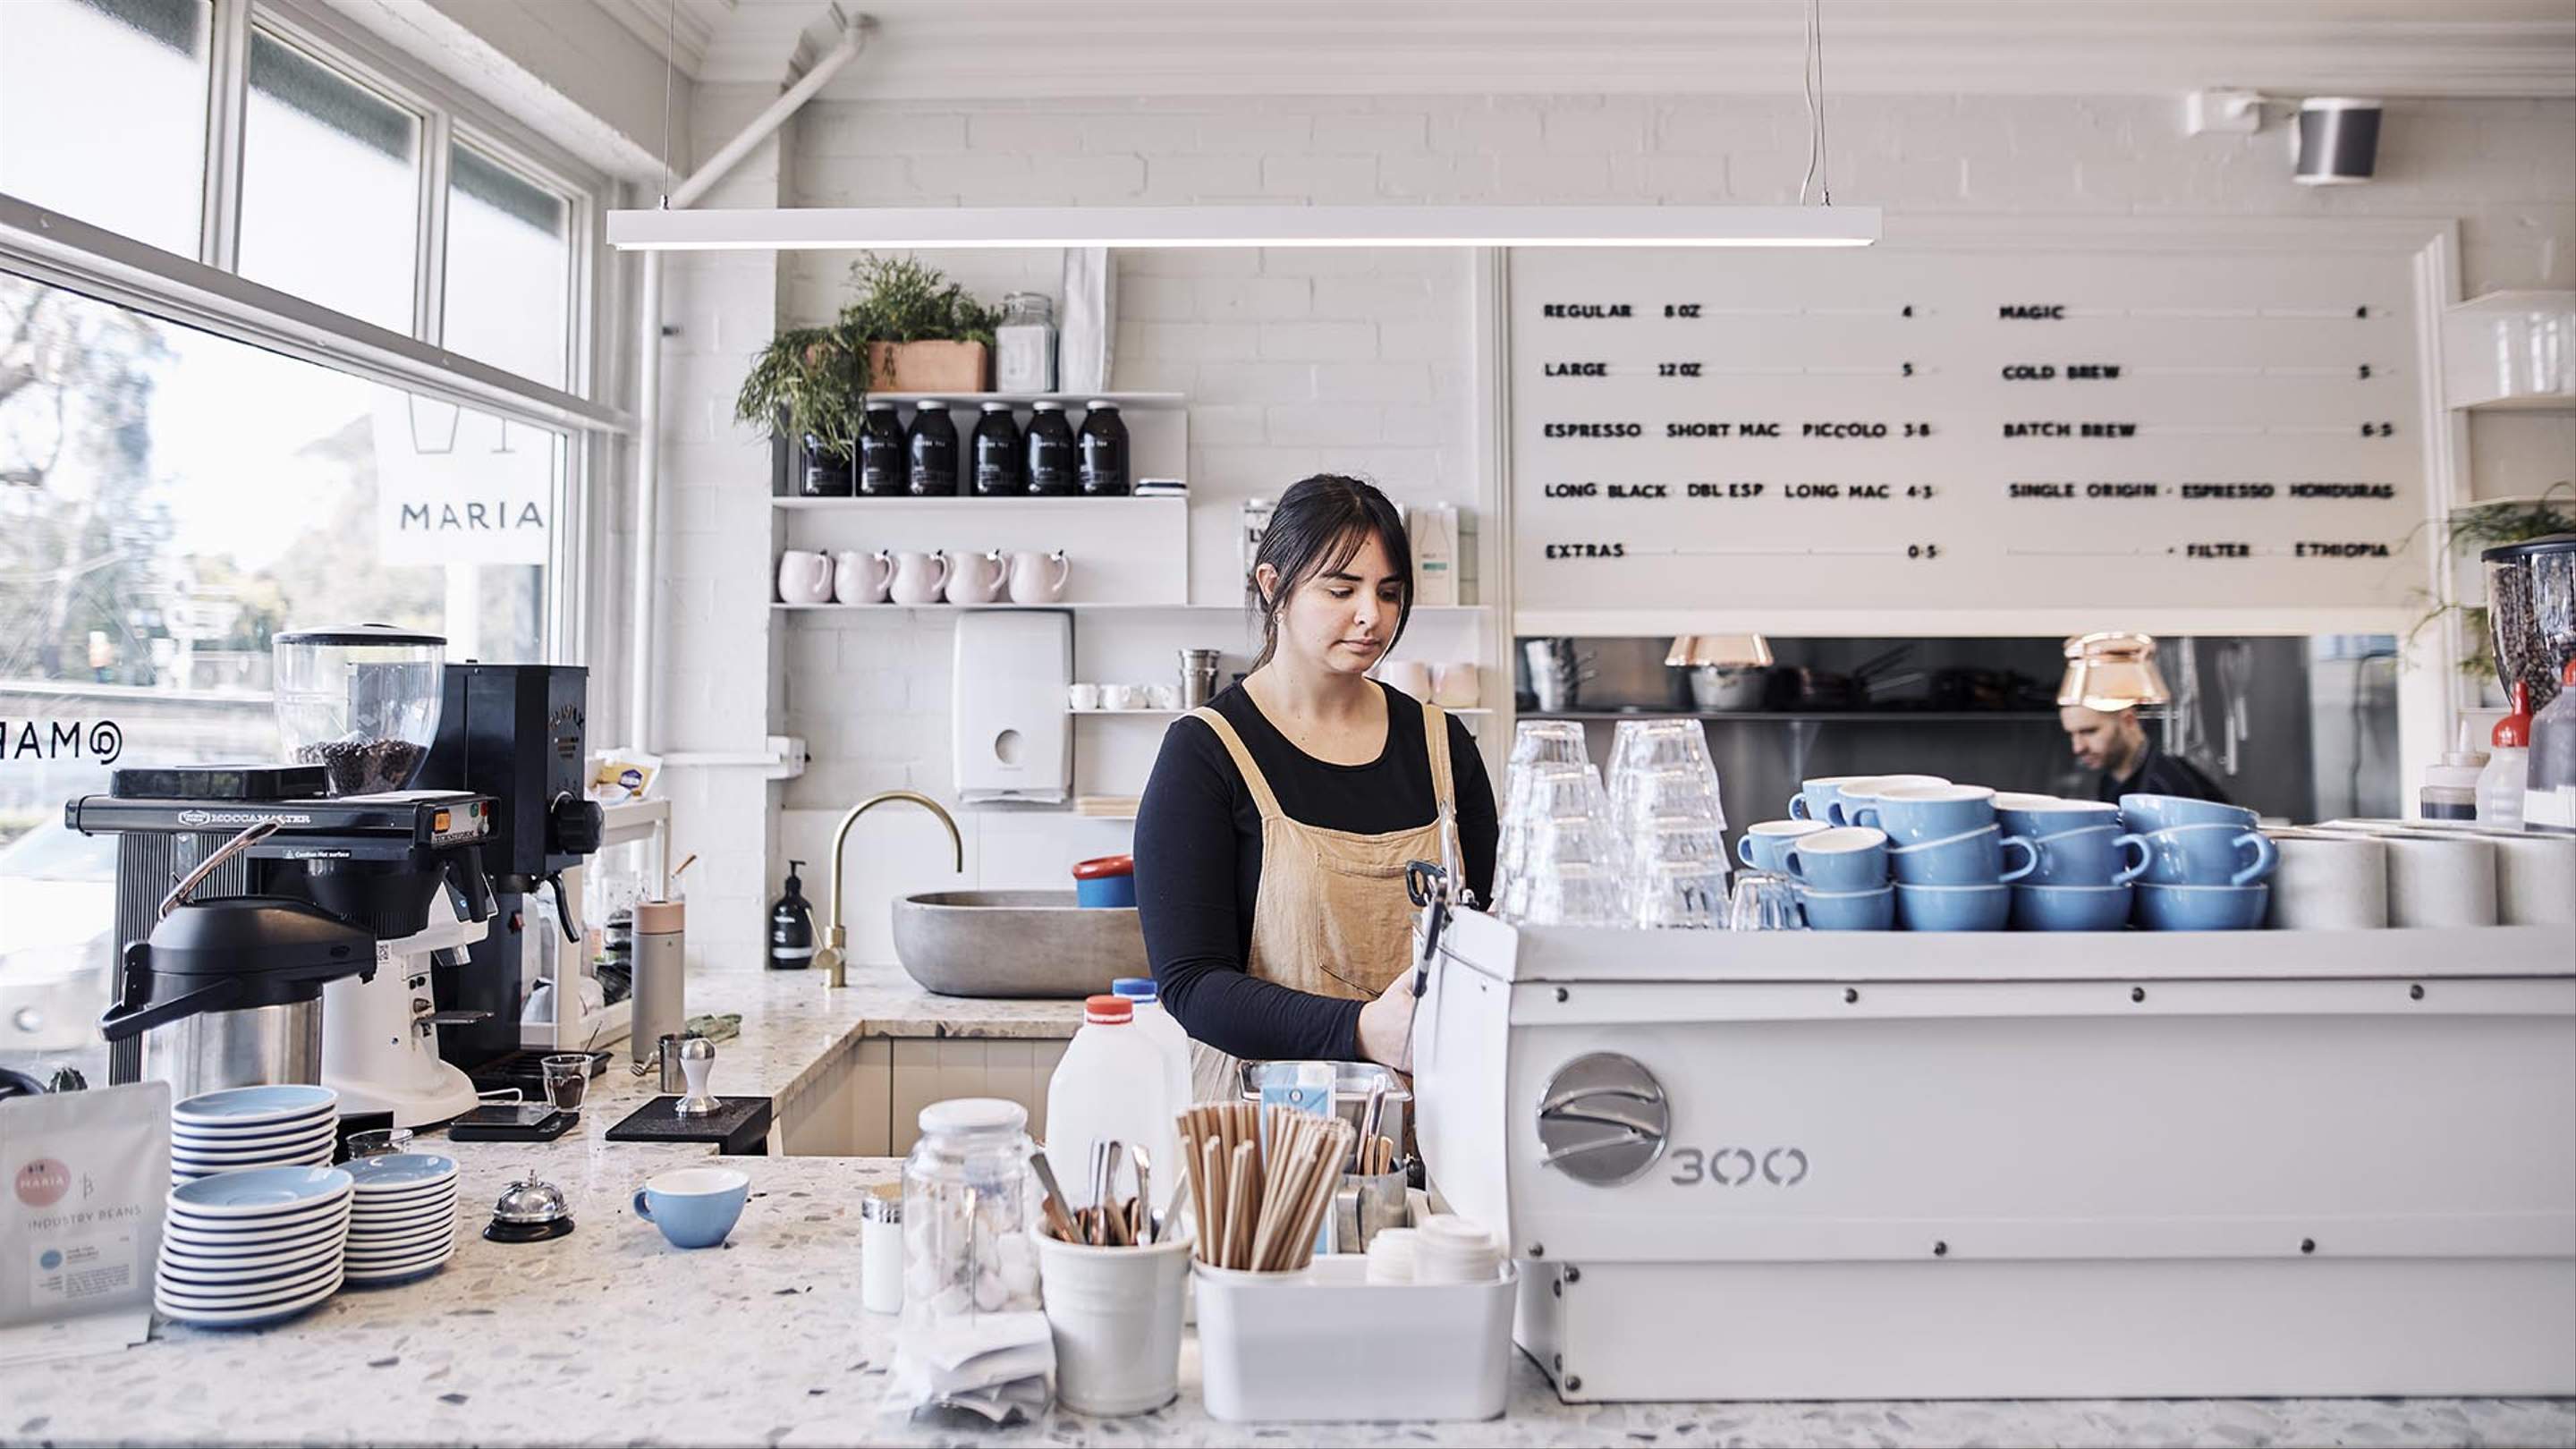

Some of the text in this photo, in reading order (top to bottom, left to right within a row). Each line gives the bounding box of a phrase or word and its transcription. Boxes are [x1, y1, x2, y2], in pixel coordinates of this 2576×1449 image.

[1542, 302, 1633, 320] REGULAR
[1901, 303, 1914, 319] 4
[1998, 303, 2065, 321] MAGIC
[1544, 361, 1608, 378] LARGE
[1657, 361, 1677, 378] 12
[1902, 361, 1914, 378] 5
[2001, 364, 2057, 382] COLD
[2065, 363, 2122, 381] BREW
[1543, 422, 1643, 439] ESPRESSO
[1665, 421, 1732, 439] SHORT
[1738, 422, 1782, 439] MAC
[1801, 421, 1888, 440] PICCOLO
[2002, 420, 2072, 439] BATCH
[2079, 422, 2138, 439] BREW
[1544, 481, 1598, 499] LONG
[1606, 483, 1668, 500] BLACK
[1686, 482, 1724, 499] DBL
[1727, 482, 1765, 499] ESP
[1784, 483, 1841, 500] LONG
[1847, 483, 1891, 500] MAC
[2008, 481, 2397, 501] SINGLE ORIGIN ESPRESSO HONDURAS
[402, 502, 544, 530] MARIA
[1544, 542, 1626, 561] EXTRAS
[2186, 541, 2391, 560] FILTER ETHIOPIA
[1670, 1147, 1809, 1188] 300
[20, 1174, 65, 1190] MARIA
[28, 1203, 143, 1232] INDUSTRY BEANS
